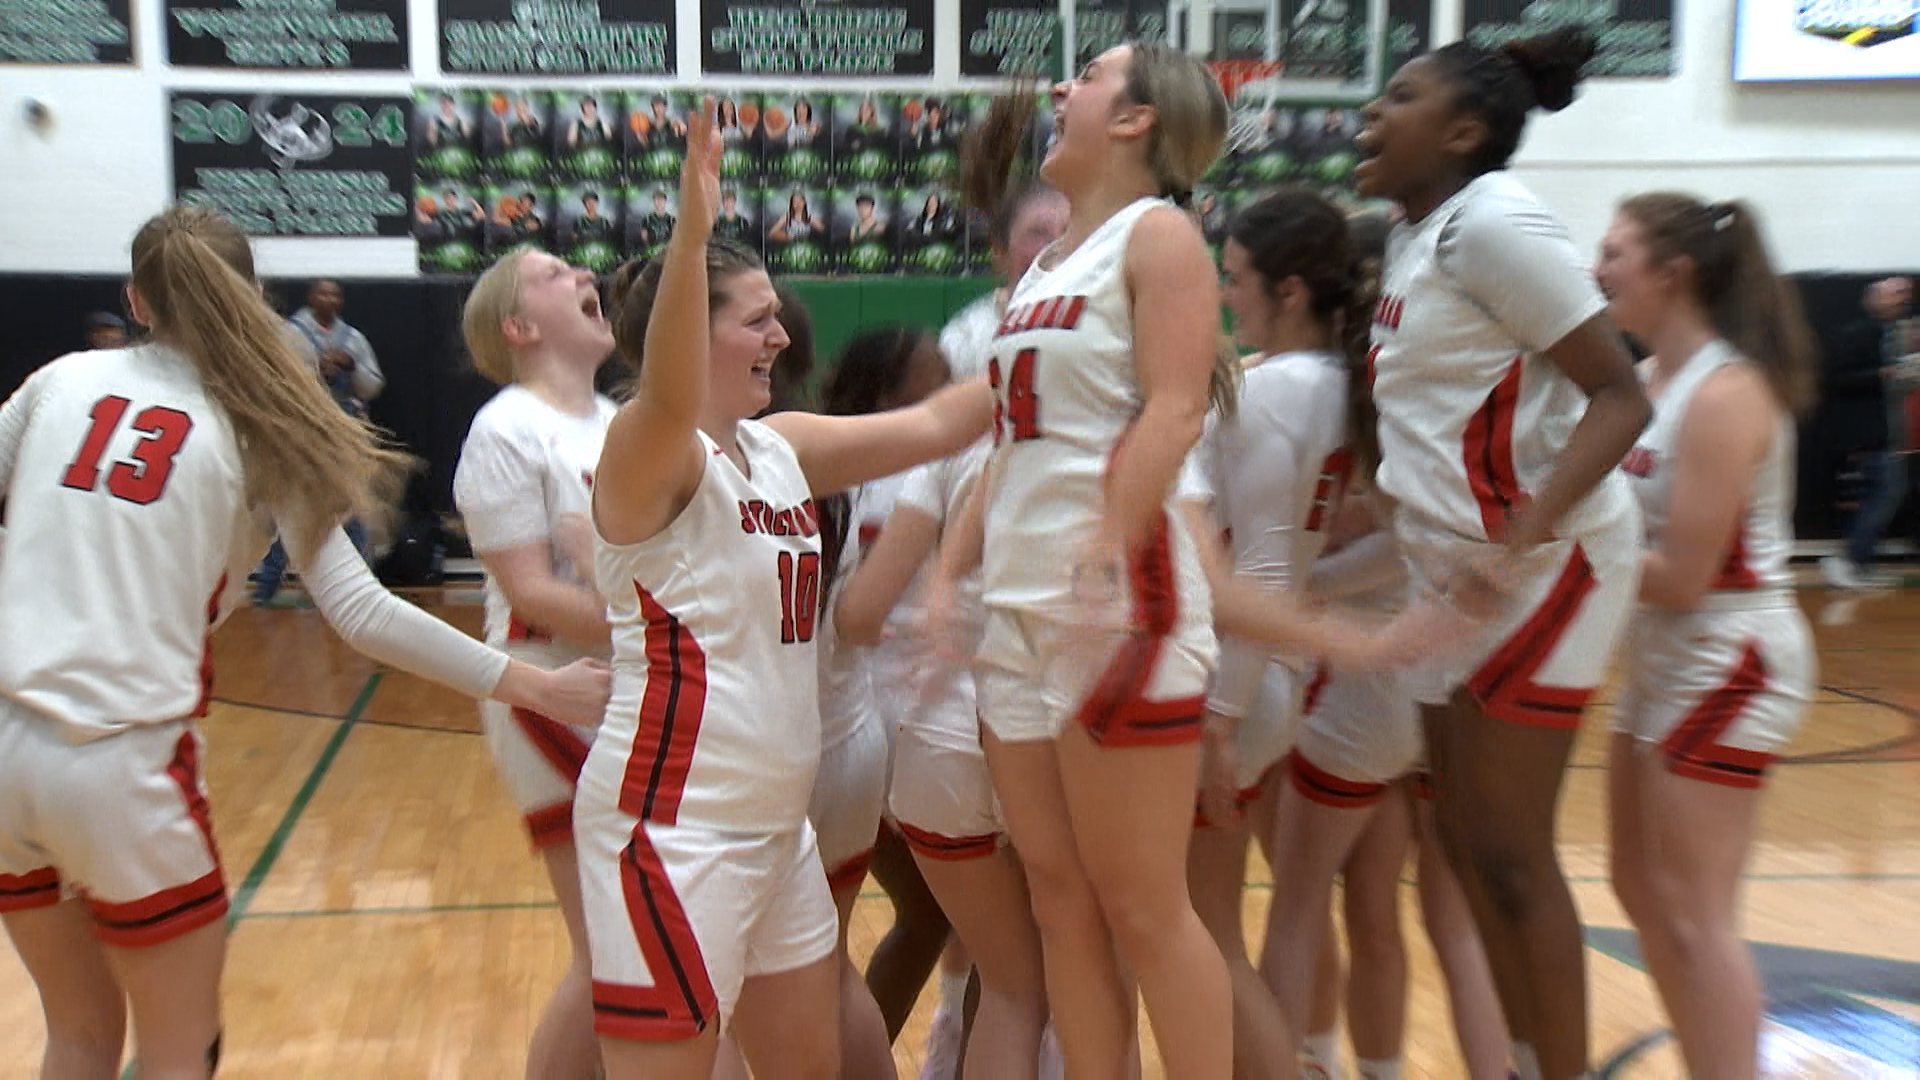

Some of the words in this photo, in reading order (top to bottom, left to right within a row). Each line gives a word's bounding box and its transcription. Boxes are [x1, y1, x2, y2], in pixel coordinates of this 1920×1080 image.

[332, 102, 408, 147] 24
[60, 394, 195, 505] 13
[777, 550, 820, 644] 10
